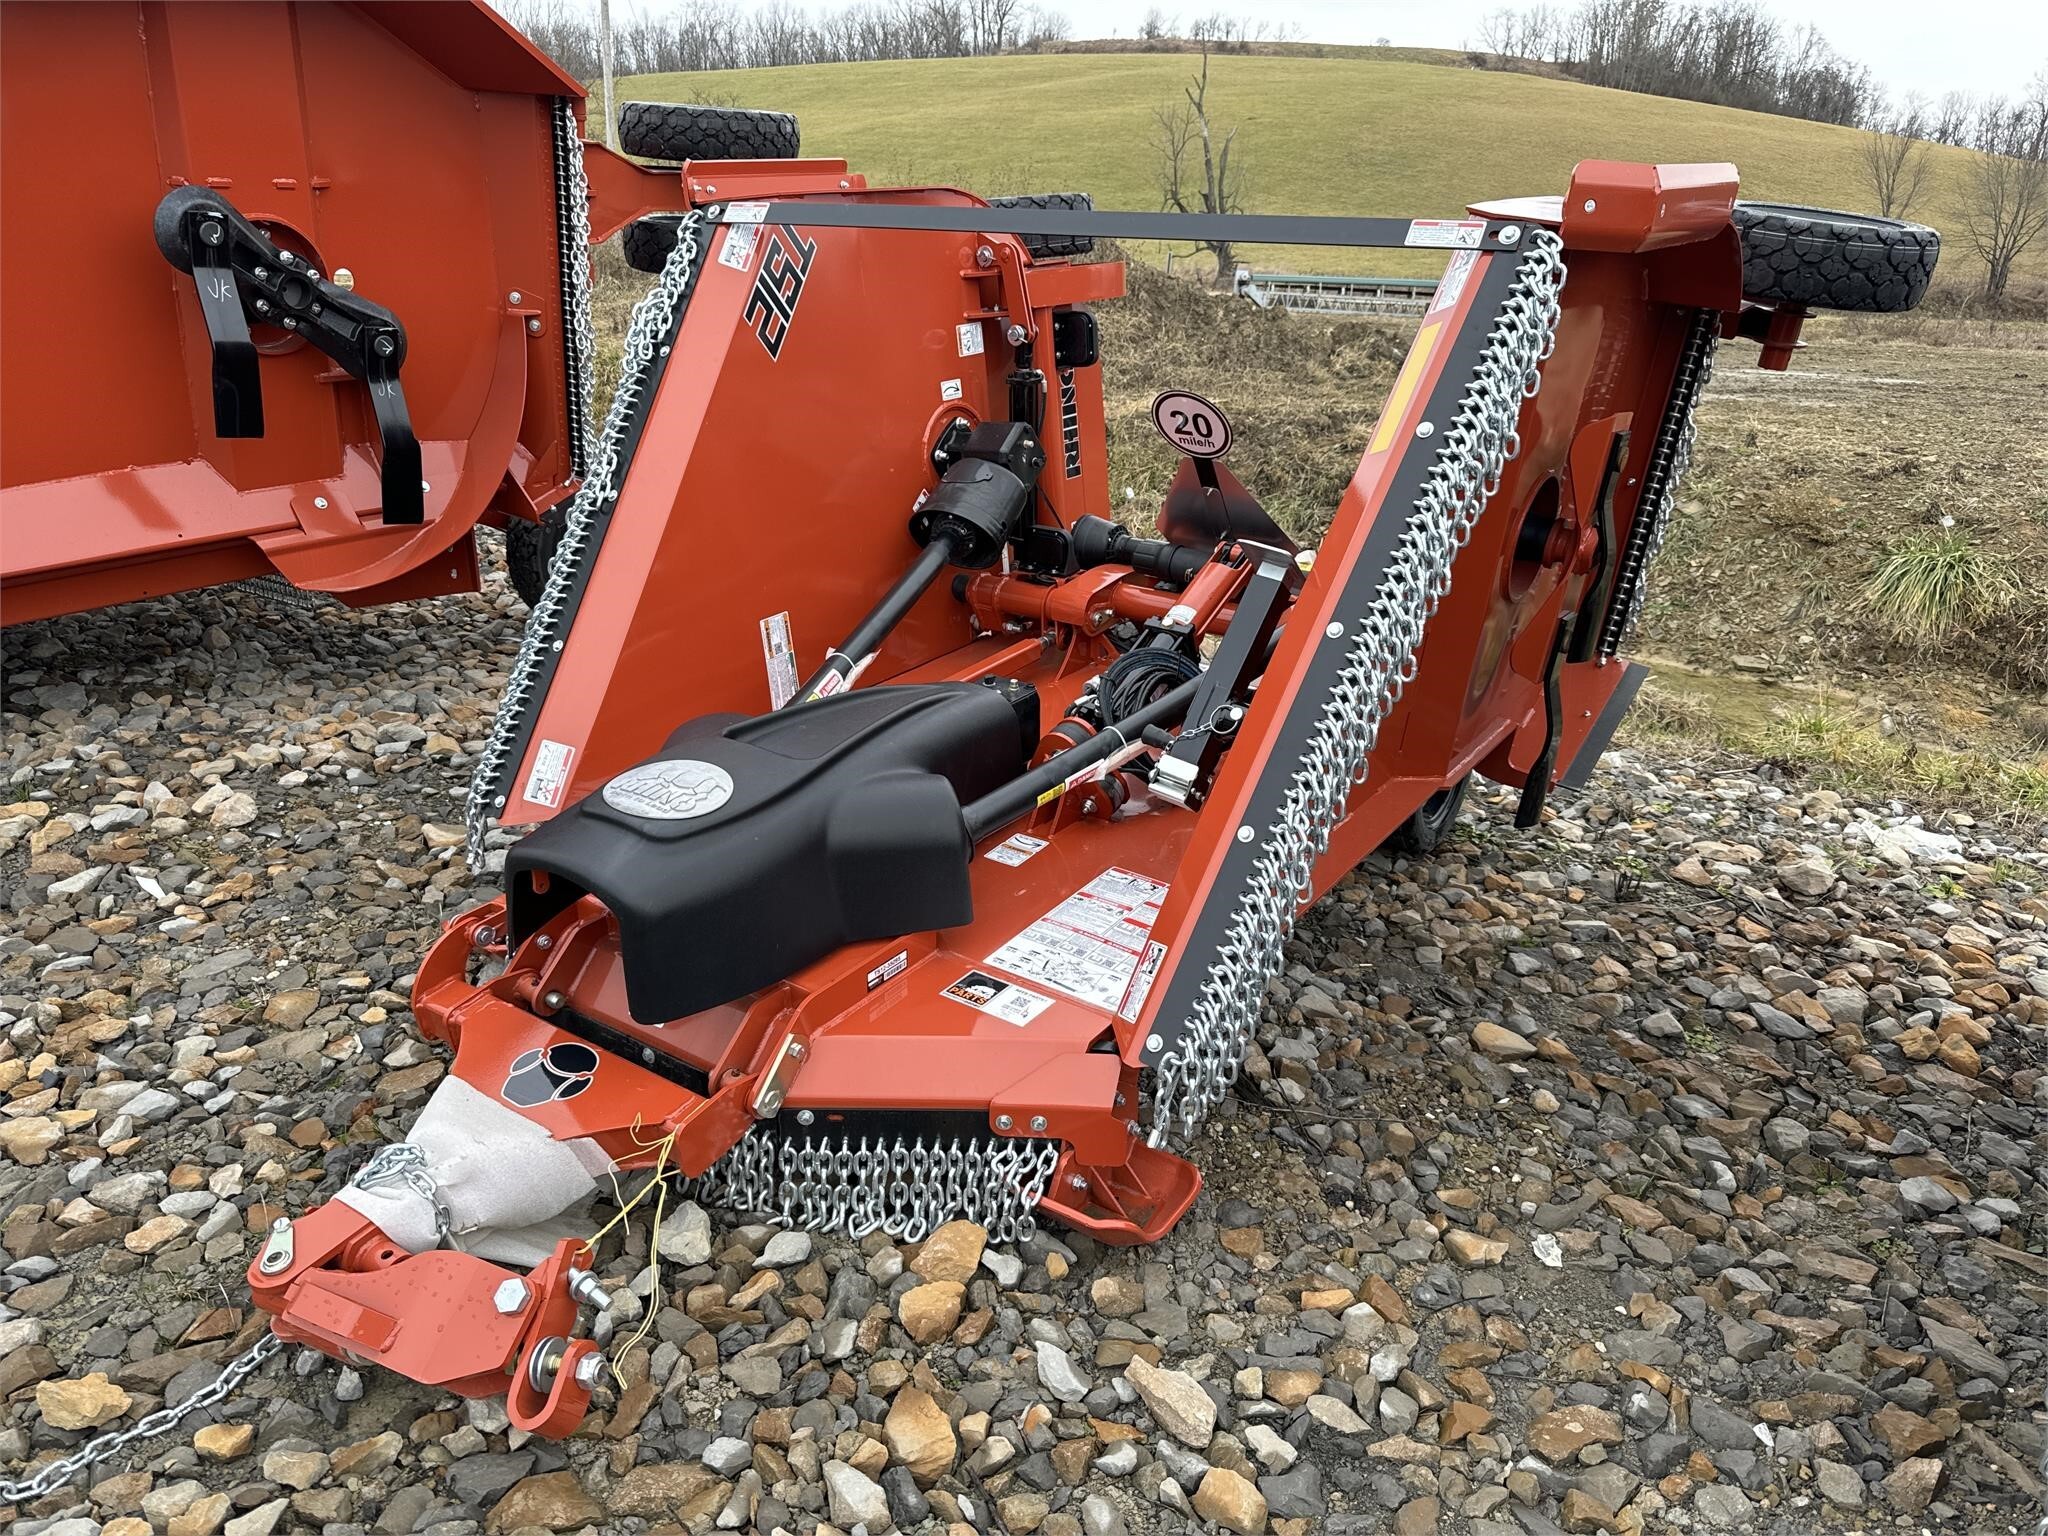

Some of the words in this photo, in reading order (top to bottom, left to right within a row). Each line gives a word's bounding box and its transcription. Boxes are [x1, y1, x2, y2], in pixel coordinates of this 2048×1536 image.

[1170, 410, 1213, 439] 20
[1178, 437, 1216, 449] mile/h
[948, 986, 988, 1005] PARTS
